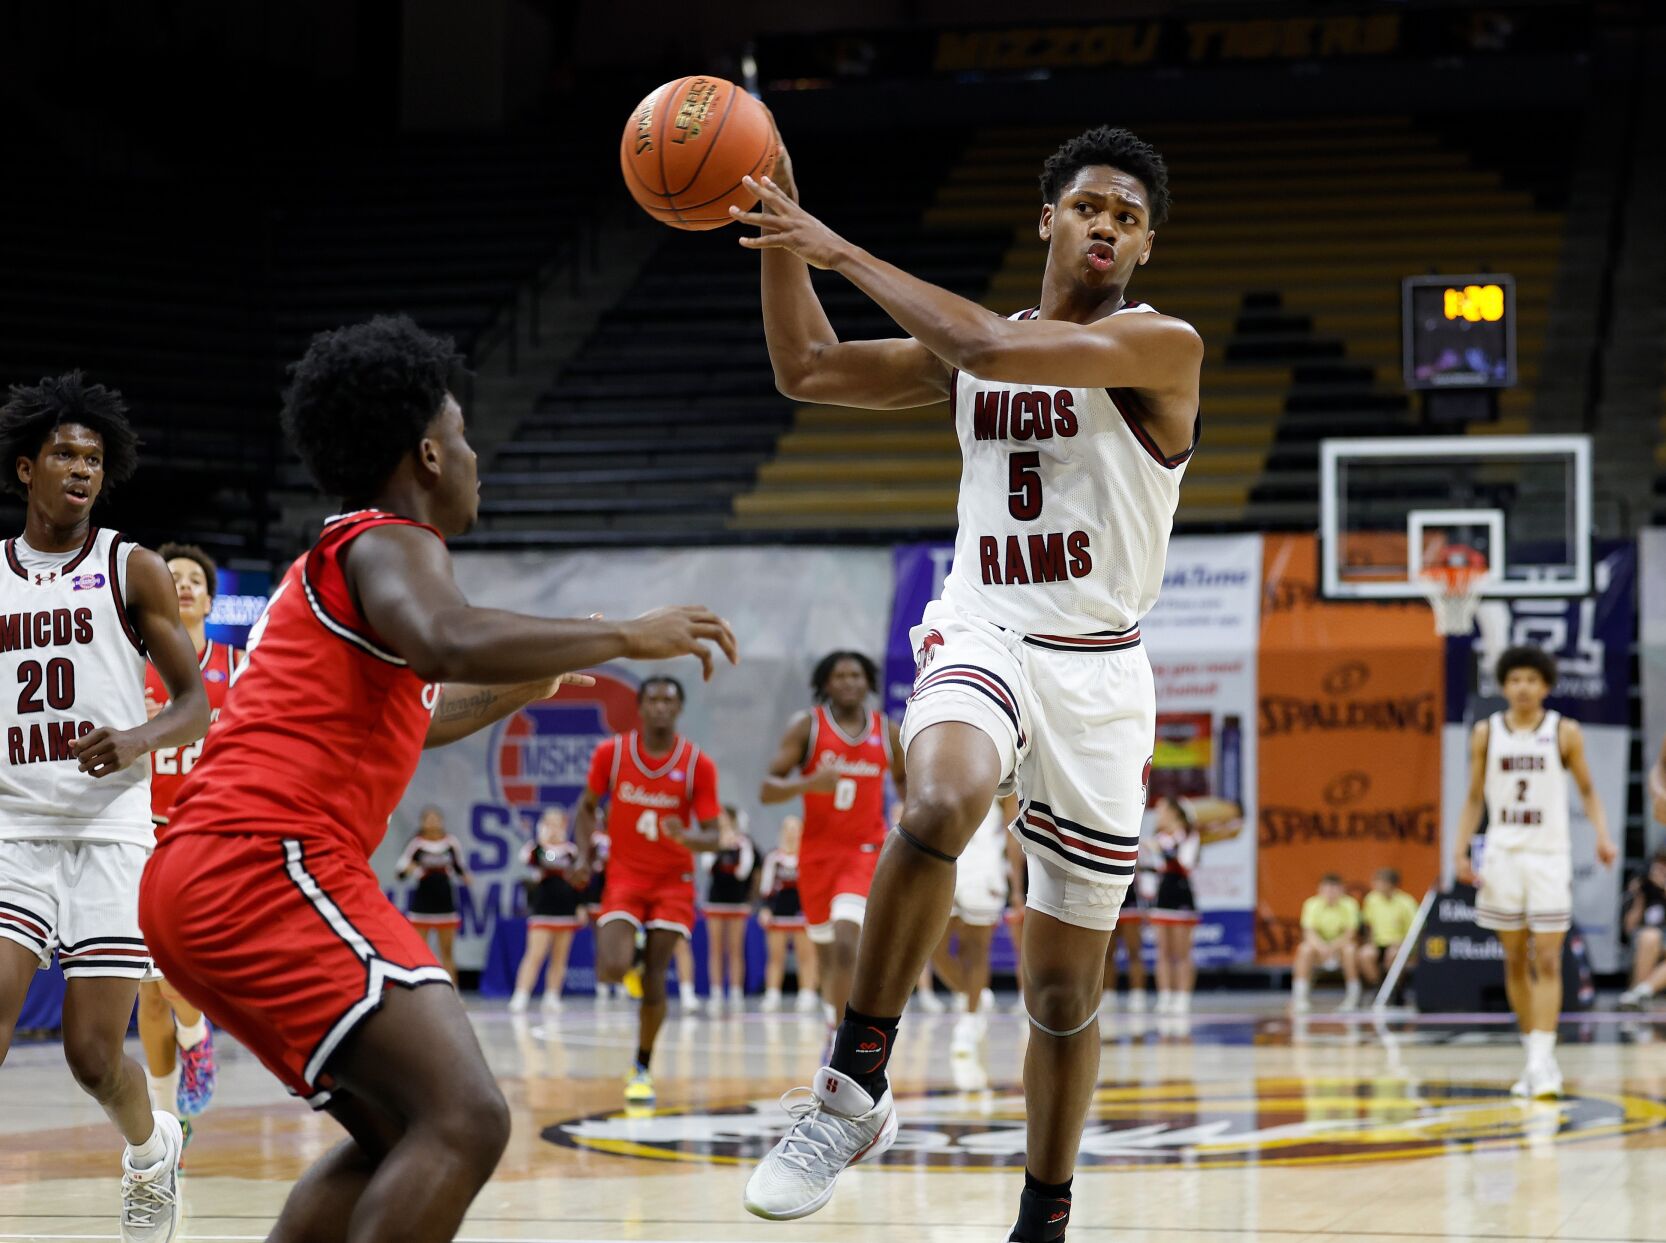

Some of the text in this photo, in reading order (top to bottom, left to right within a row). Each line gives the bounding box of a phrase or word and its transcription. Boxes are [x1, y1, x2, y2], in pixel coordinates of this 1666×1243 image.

[974, 389, 1079, 441] MICDS
[1008, 451, 1043, 521] 5
[980, 530, 1092, 585] RAMS
[0, 607, 94, 654] MICDS
[17, 657, 75, 715] 20
[1258, 695, 1437, 736] SPALDING
[834, 778, 857, 811] 0
[1517, 780, 1528, 802] 2
[635, 809, 660, 842] 4
[1258, 804, 1437, 847] SPALDING
